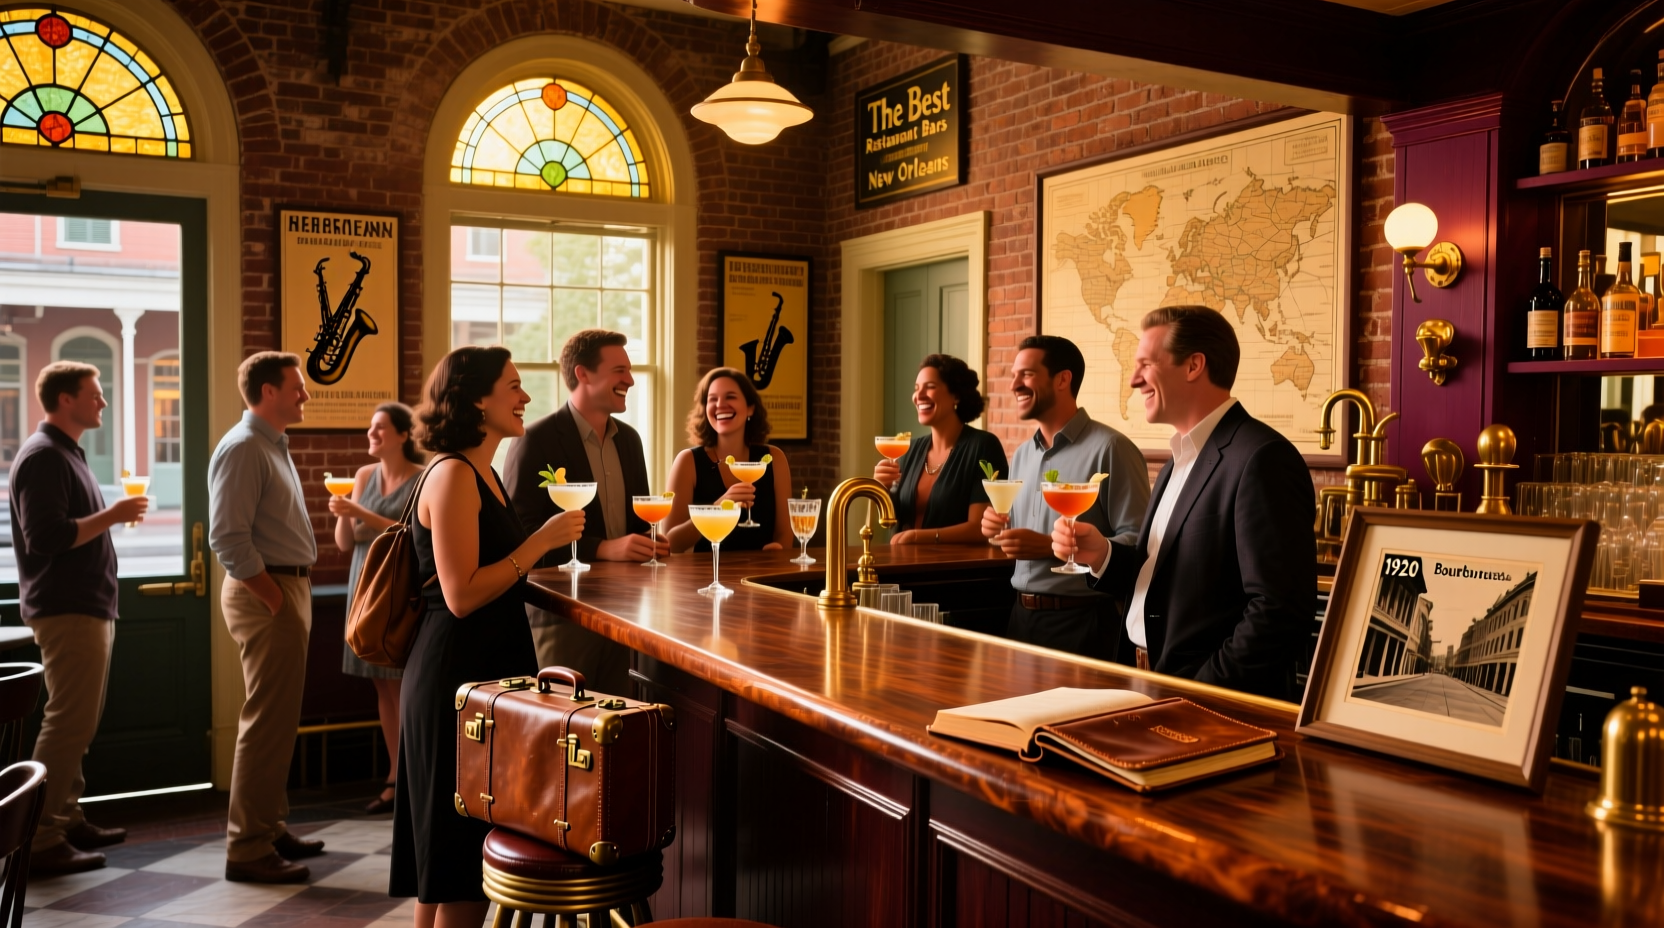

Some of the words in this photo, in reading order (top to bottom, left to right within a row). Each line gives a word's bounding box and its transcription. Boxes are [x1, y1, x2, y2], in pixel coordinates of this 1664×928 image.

[868, 97, 903, 133] The
[907, 81, 950, 122] Best
[921, 119, 947, 137] Bars
[898, 157, 948, 181] Orleans
[1385, 557, 1419, 577] 1920
